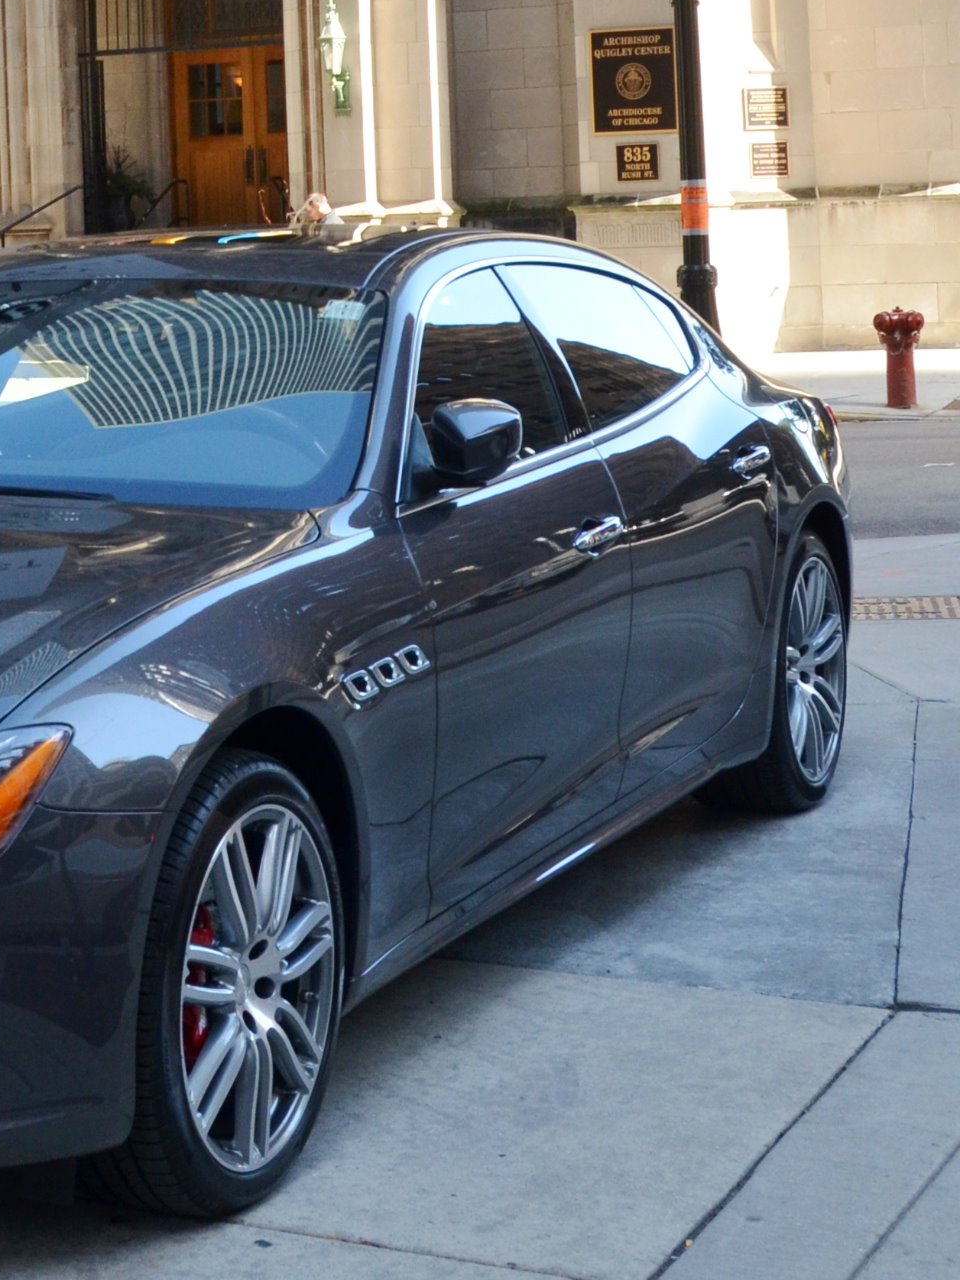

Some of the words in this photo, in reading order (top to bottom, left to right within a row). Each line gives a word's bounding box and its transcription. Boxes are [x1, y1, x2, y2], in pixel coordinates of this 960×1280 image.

[603, 34, 661, 47] ARCHBISHOP
[594, 47, 633, 60] QUIGLEY
[634, 45, 671, 56] CENTER
[607, 106, 663, 117] ARCHDIOCESE
[611, 117, 623, 126] OF
[623, 116, 659, 126] CHICAGO
[623, 146, 651, 163] 835
[625, 162, 651, 171] NORTH
[621, 170, 642, 179] RUSH
